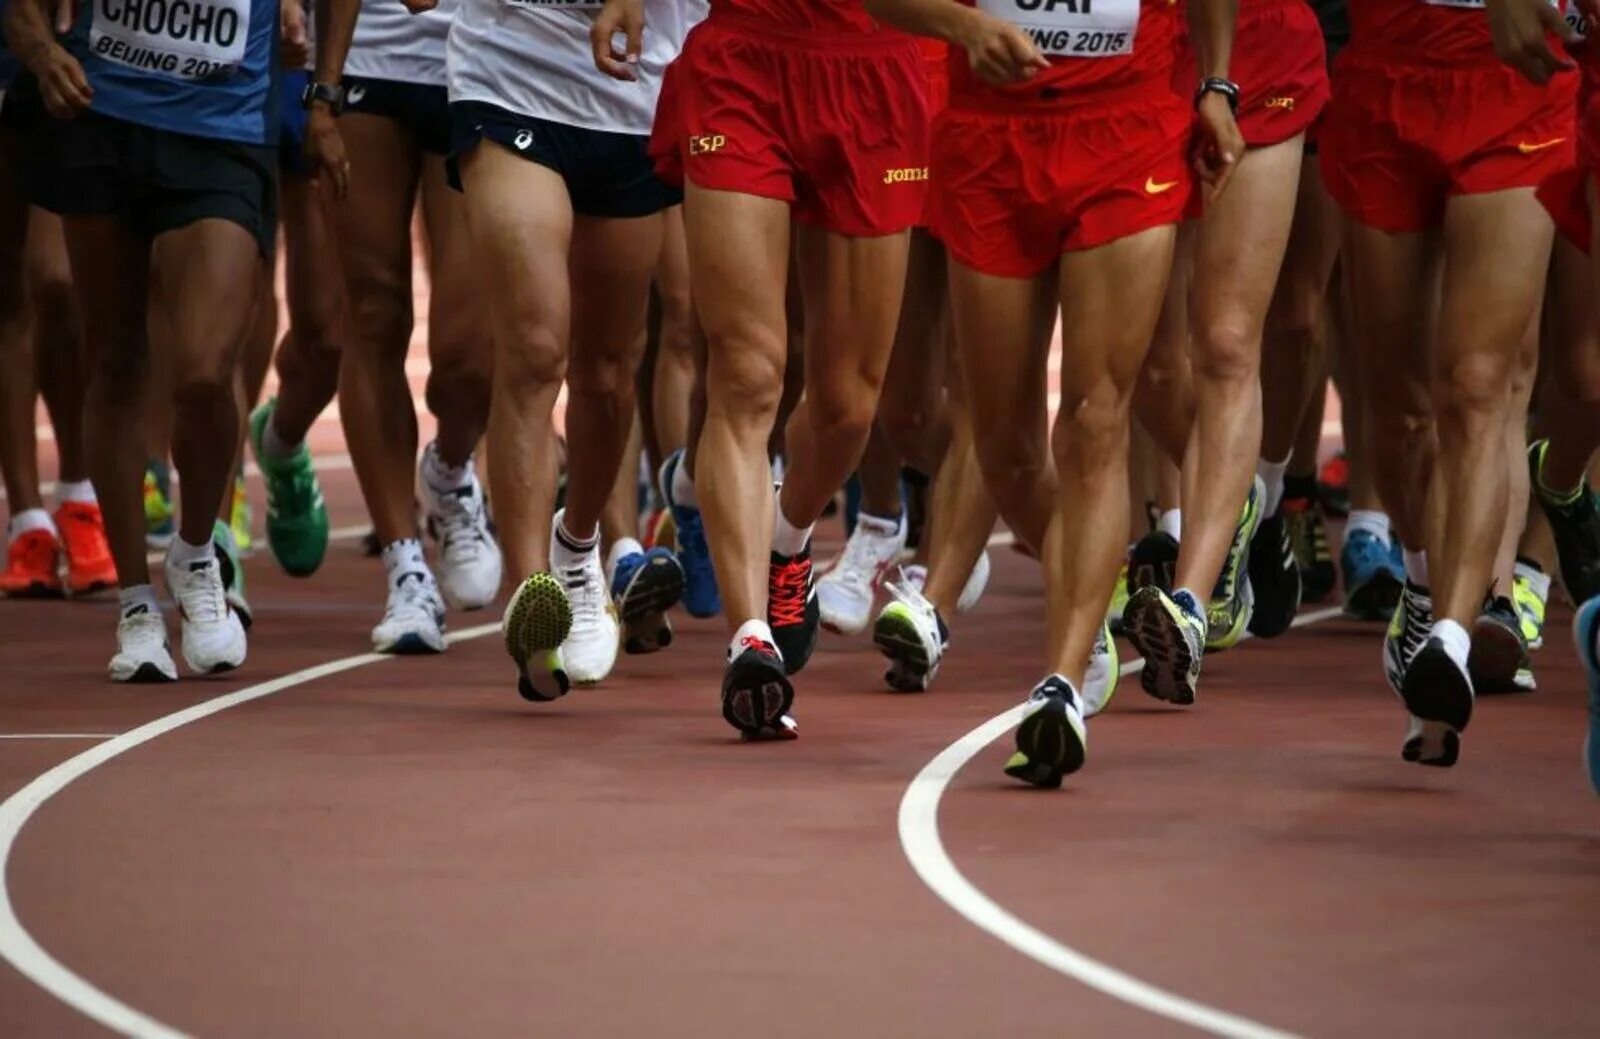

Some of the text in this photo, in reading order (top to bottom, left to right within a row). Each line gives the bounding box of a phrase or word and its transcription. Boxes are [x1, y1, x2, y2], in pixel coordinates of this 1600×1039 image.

[102, 0, 238, 47] CHOCHO
[96, 36, 178, 71] BEIJING
[1073, 31, 1129, 52] 2015
[690, 135, 726, 155] ESP
